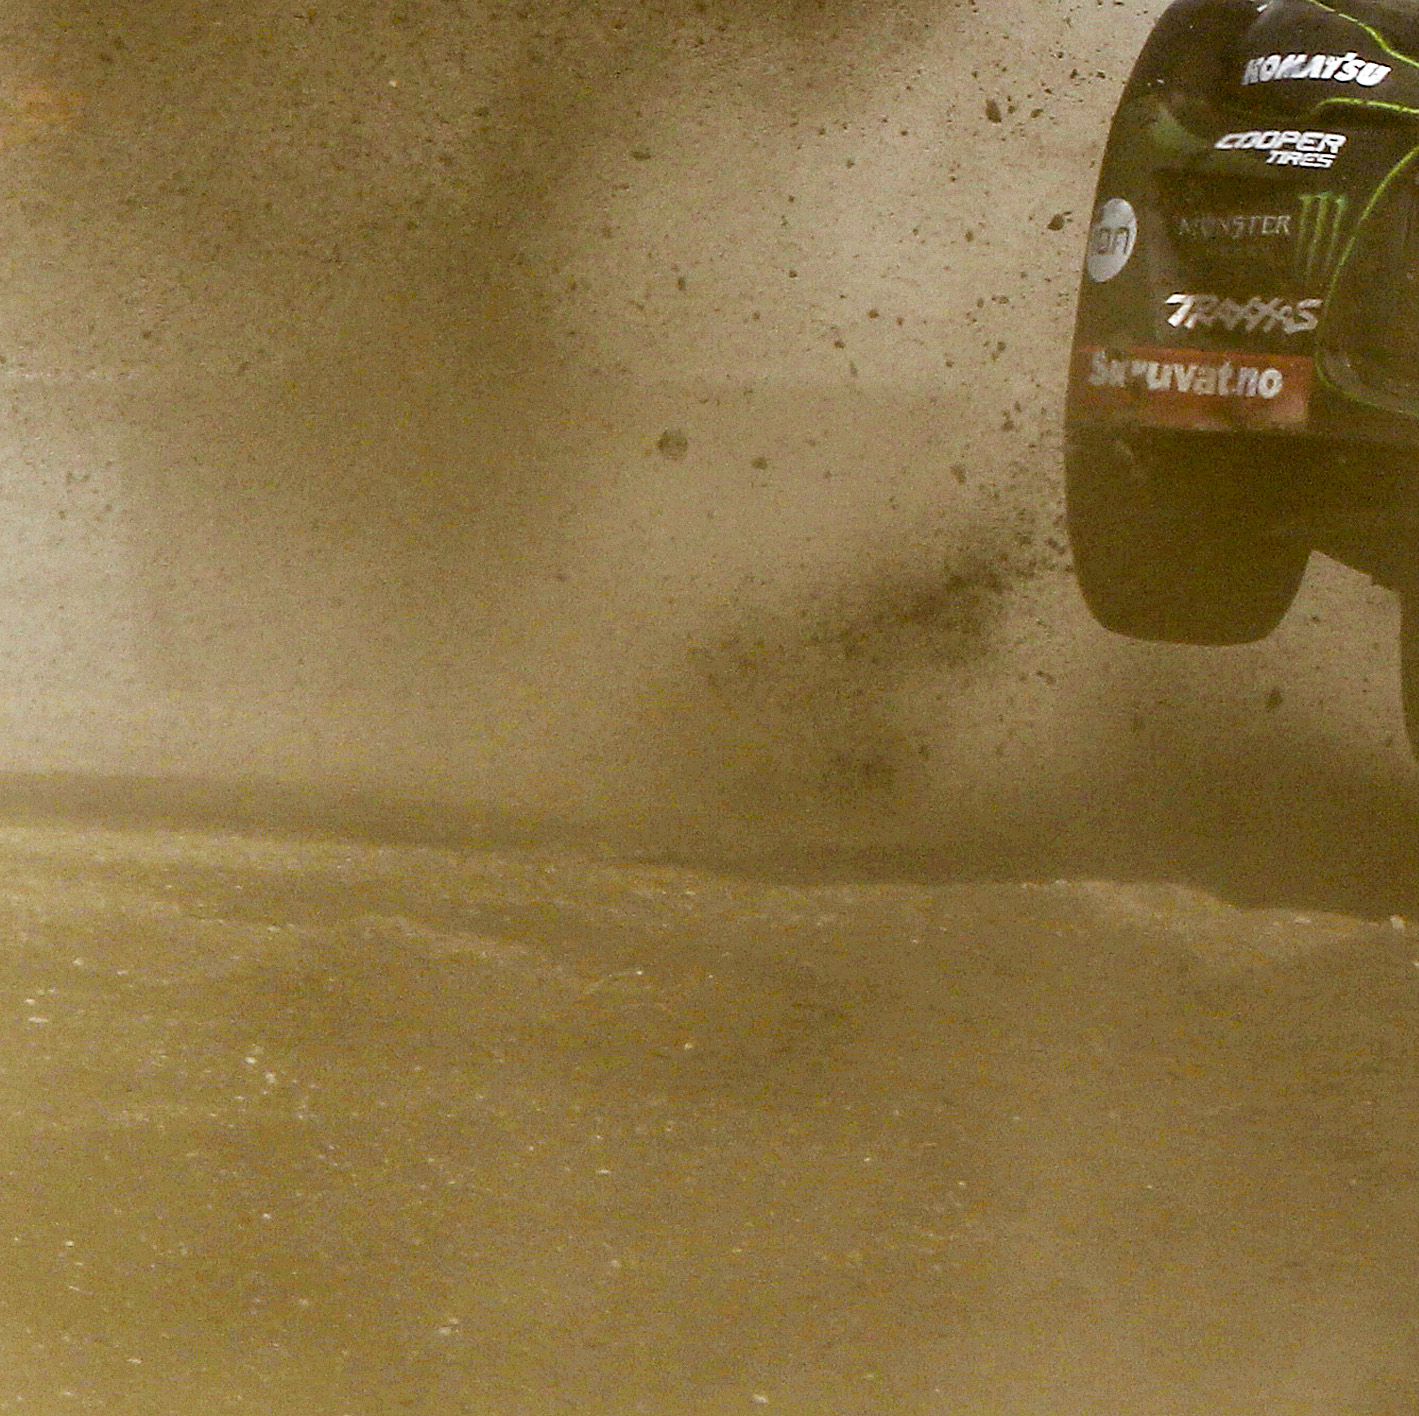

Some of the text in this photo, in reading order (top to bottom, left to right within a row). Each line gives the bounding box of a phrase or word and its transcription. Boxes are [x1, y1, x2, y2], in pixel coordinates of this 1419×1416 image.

[1242, 52, 1392, 87] KOMATSU
[1214, 130, 1347, 154] COOPER
[1266, 151, 1337, 169] TIRES
[1164, 293, 1325, 334] TRAXXAS
